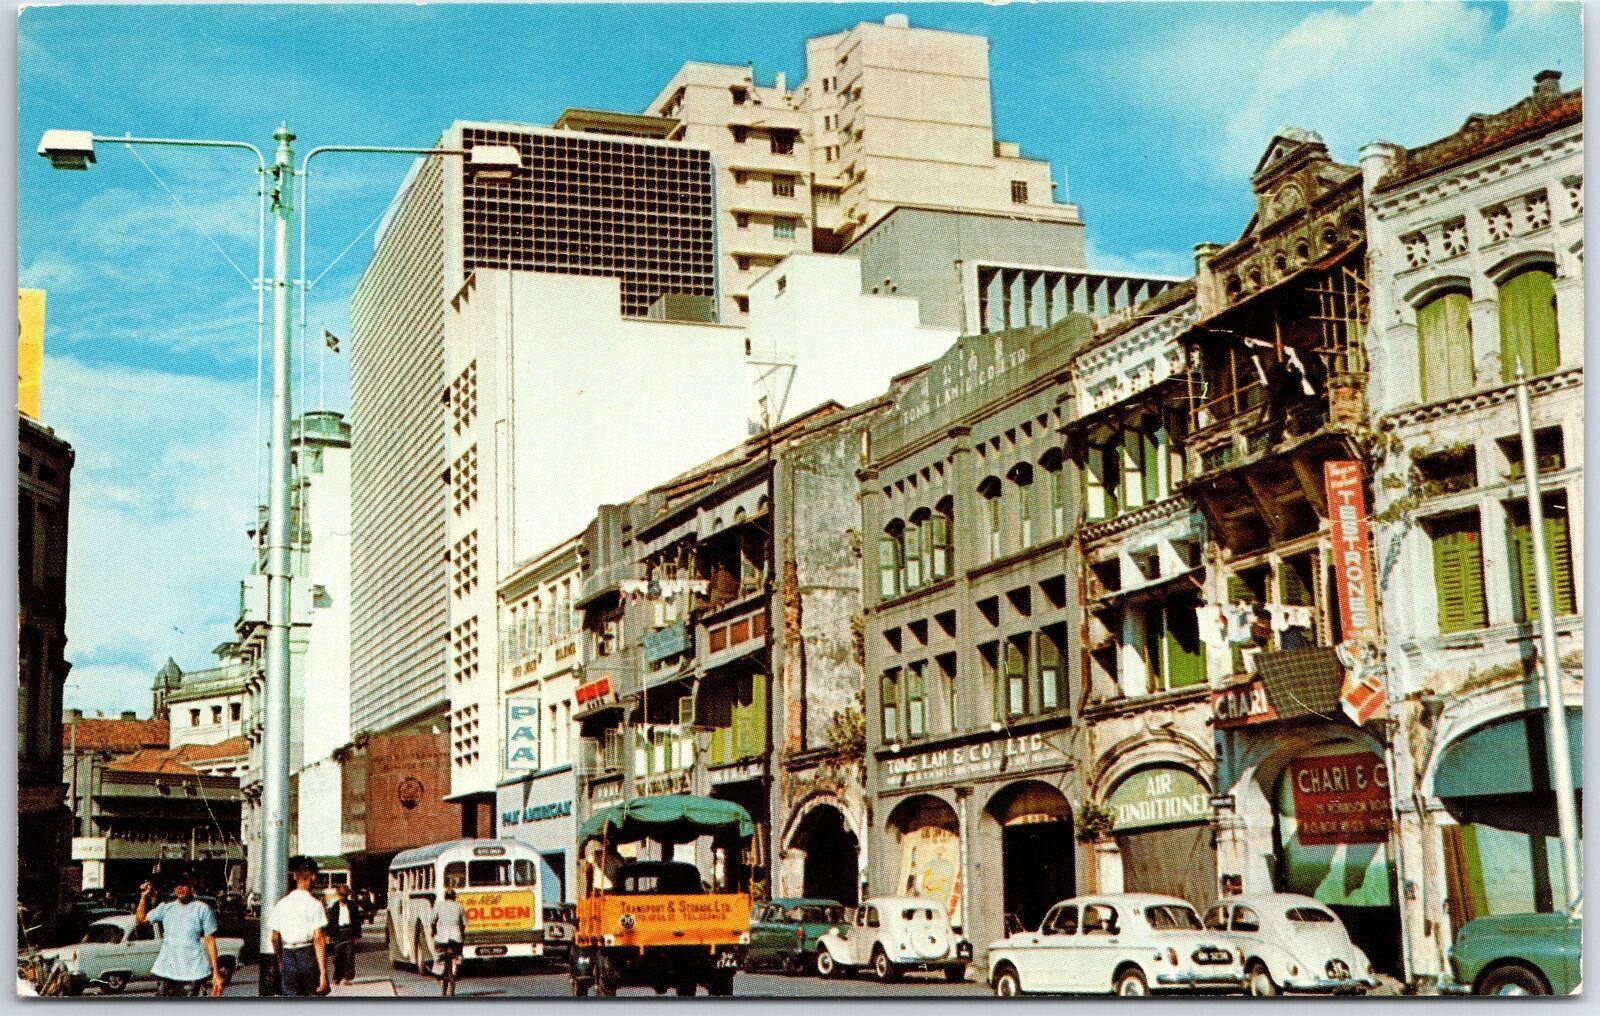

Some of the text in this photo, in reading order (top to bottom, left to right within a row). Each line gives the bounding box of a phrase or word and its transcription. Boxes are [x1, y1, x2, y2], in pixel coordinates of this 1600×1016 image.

[903, 402, 930, 425] TONG
[936, 384, 959, 407] LAM
[1215, 687, 1268, 721] CHARI
[510, 704, 537, 762] PAA
[887, 756, 918, 775] TONG
[921, 750, 948, 769] LAM
[952, 747, 964, 764] &
[1146, 773, 1172, 797] AIR
[1298, 766, 1350, 793] CHARI
[1356, 764, 1368, 790] &
[463, 906, 531, 920] OLDEN
[667, 900, 676, 914] &
